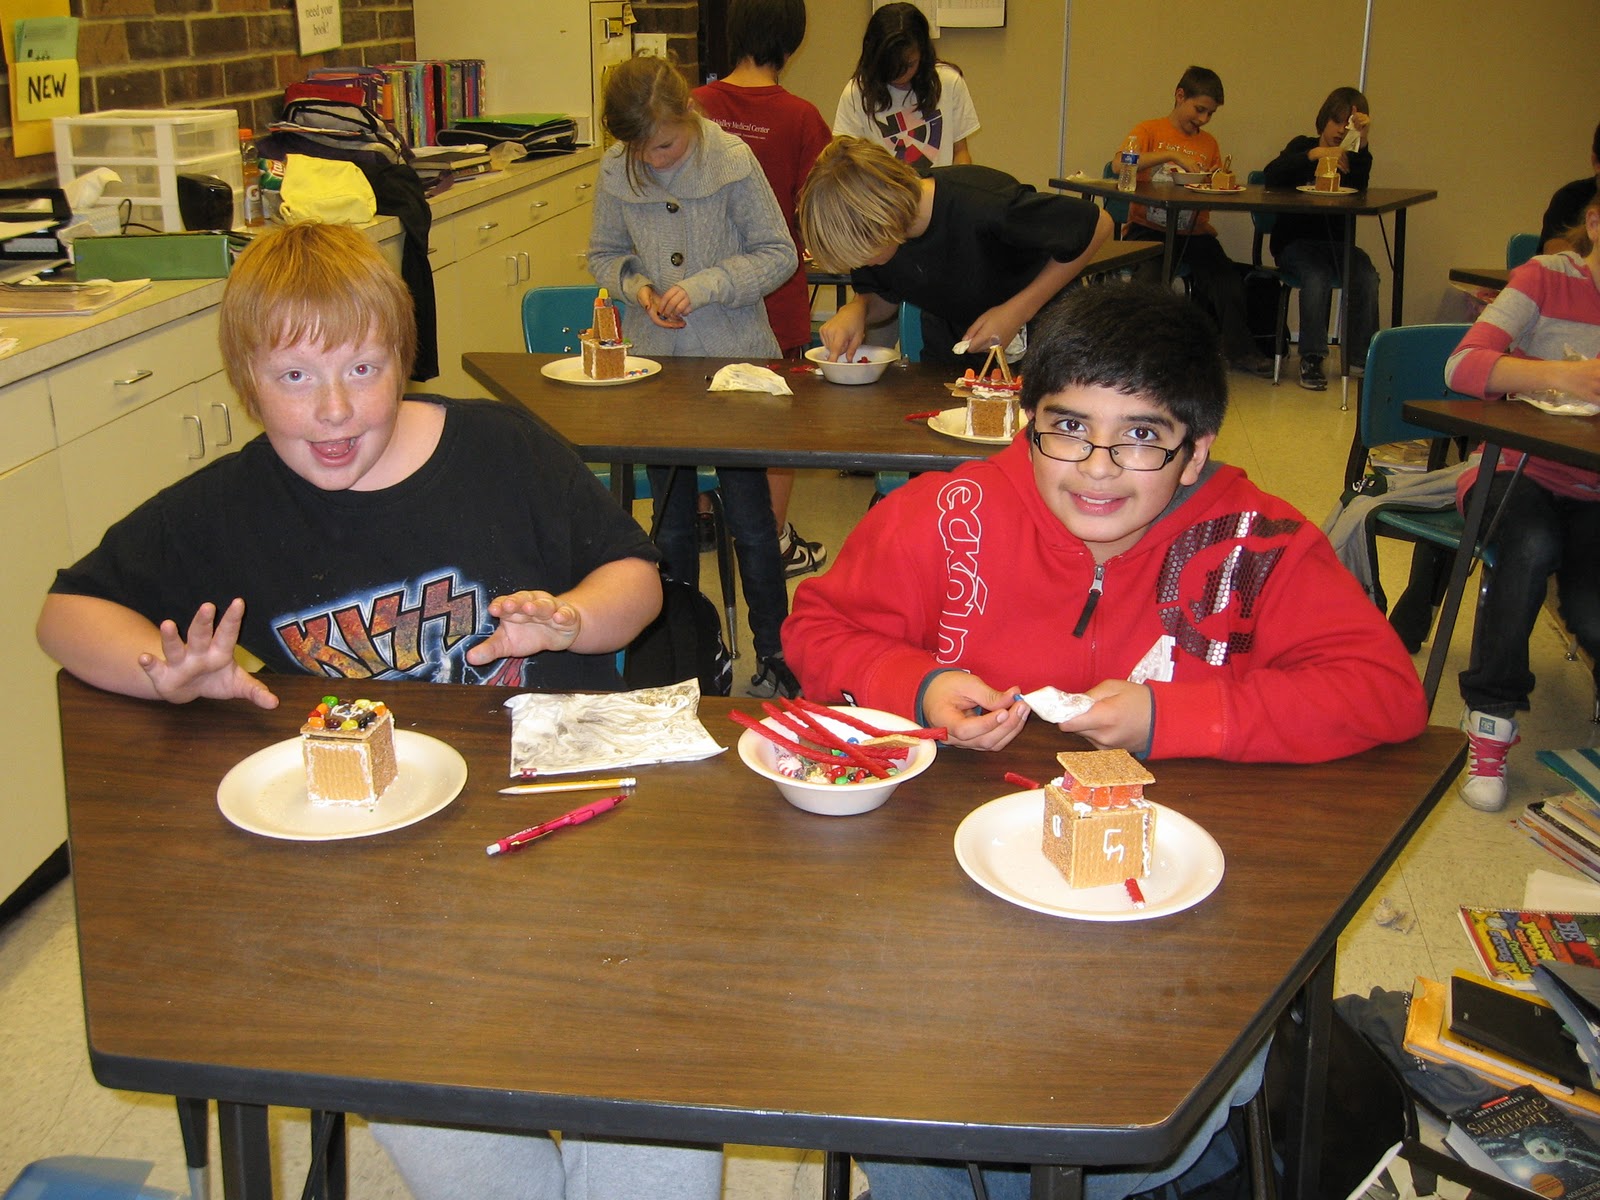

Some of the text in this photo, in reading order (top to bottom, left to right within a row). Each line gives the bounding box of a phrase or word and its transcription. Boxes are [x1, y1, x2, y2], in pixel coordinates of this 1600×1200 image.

[305, 4, 334, 19] need your
[28, 72, 67, 105] NEW
[732, 121, 752, 131] Medical
[751, 125, 771, 134] Center
[274, 573, 480, 680] KISS
[1554, 920, 1586, 942] BE
